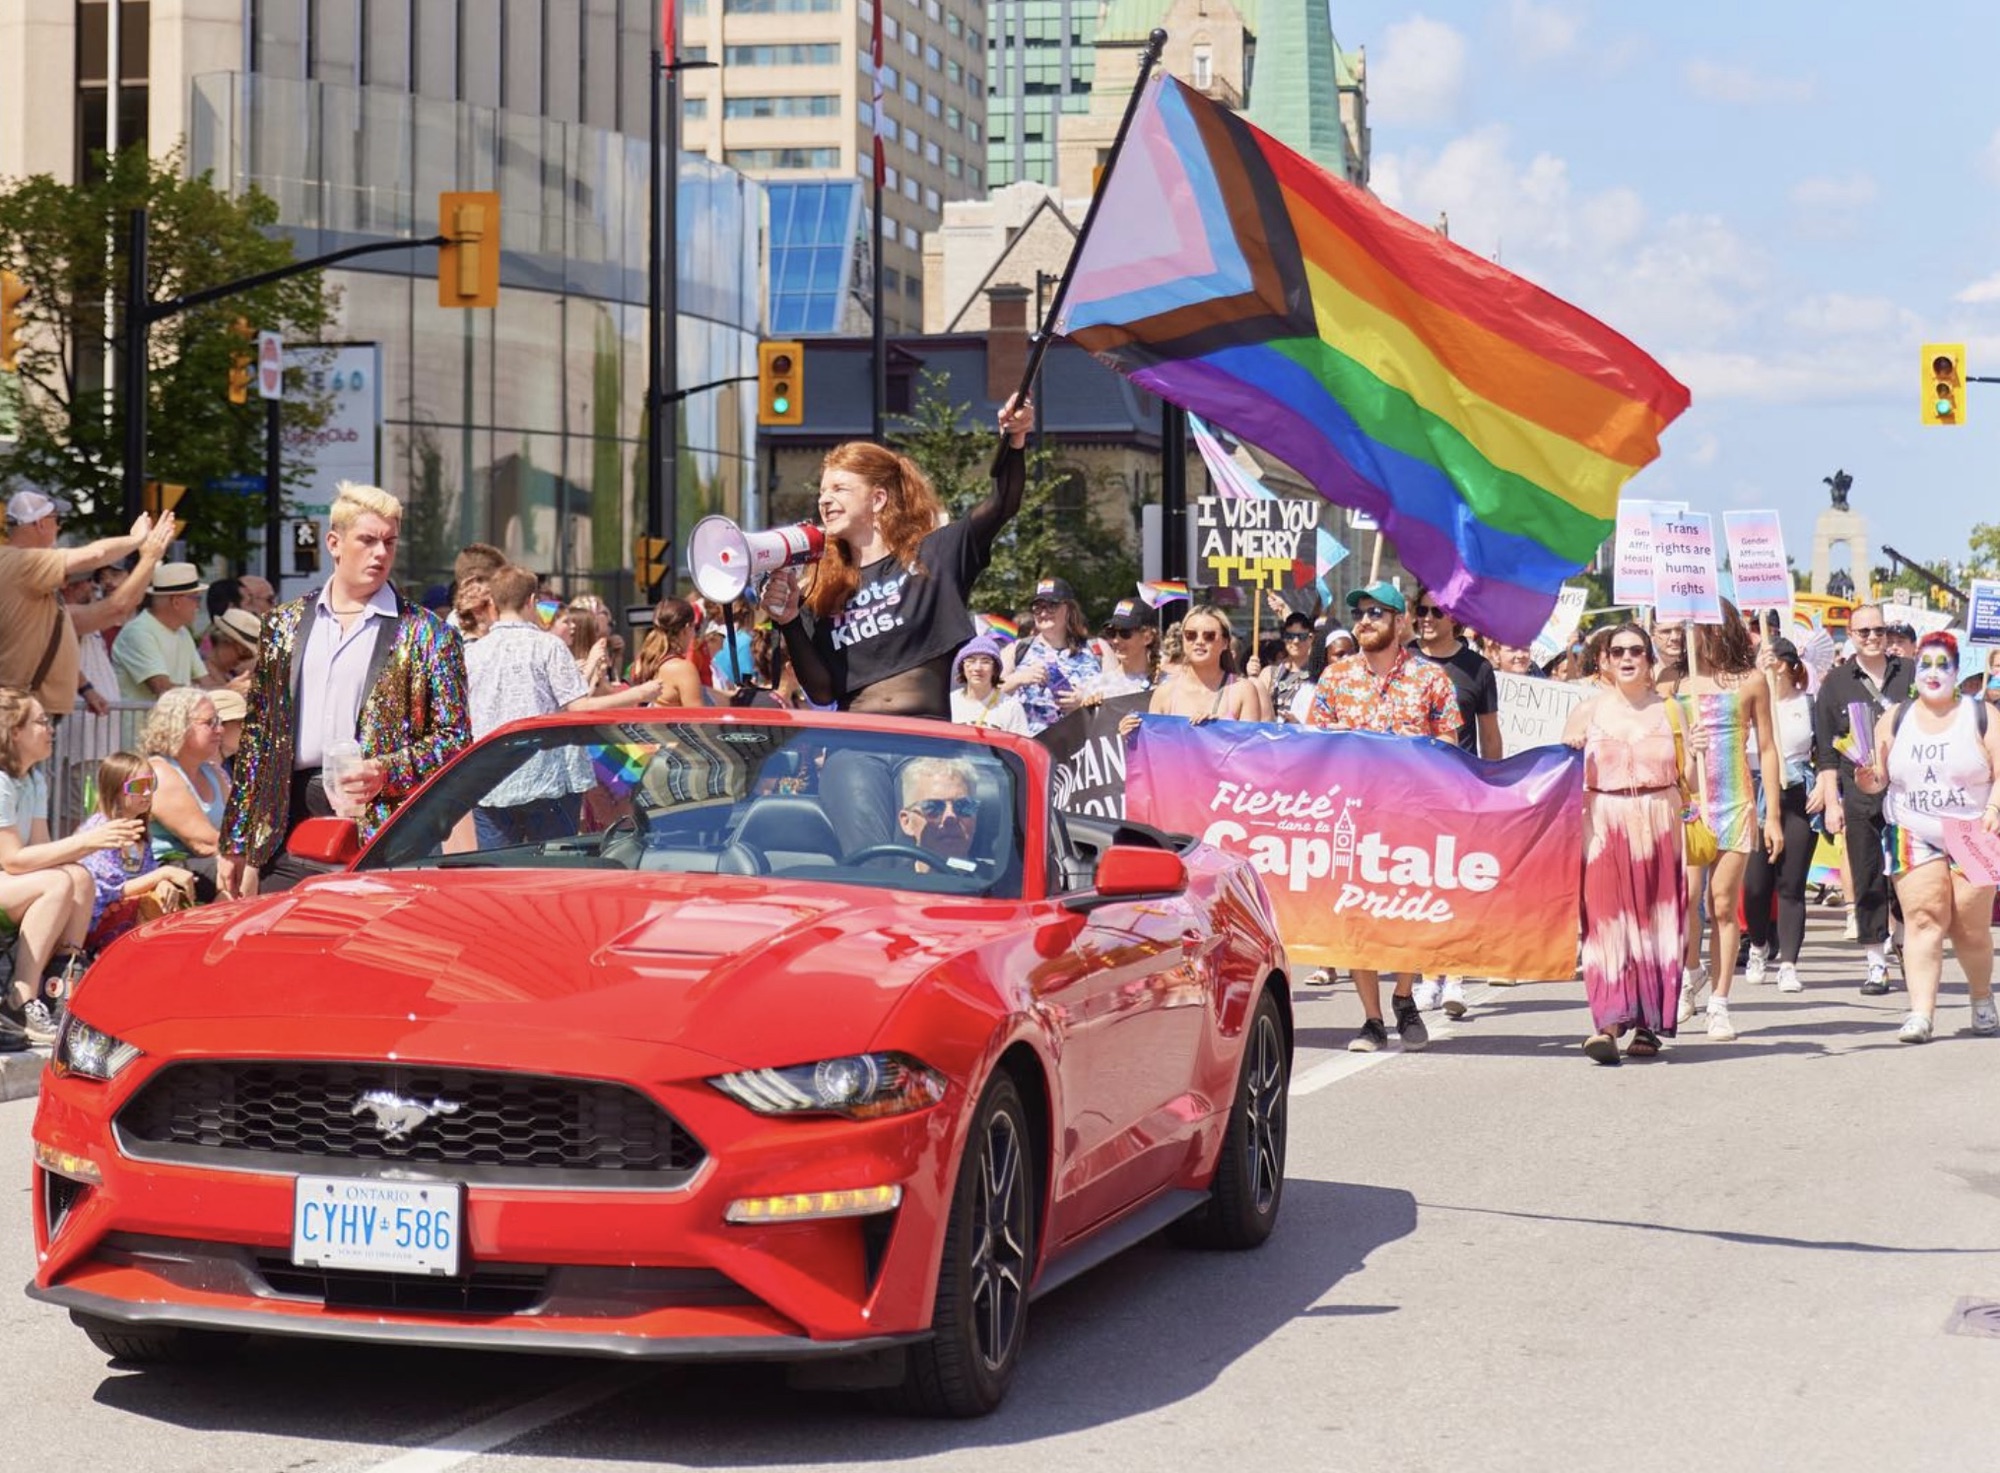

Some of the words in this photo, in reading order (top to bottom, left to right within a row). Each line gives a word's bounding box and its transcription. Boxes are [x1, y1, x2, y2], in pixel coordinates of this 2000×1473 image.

[1198, 496, 1217, 526] I
[1221, 497, 1271, 529] WISH
[1276, 499, 1321, 533] YOU
[1666, 522, 1699, 536] Trans
[1201, 528, 1225, 558] A
[1231, 528, 1303, 560] MERRY
[1655, 542, 1691, 557] rights
[1693, 545, 1711, 556] are
[1208, 555, 1292, 591] T4T
[1665, 562, 1706, 576] human
[1671, 581, 1705, 597] rights
[831, 613, 904, 651] Kids.
[1511, 713, 1546, 738] NOT
[1911, 743, 1950, 763] NOT
[1924, 765, 1937, 784] A
[1210, 780, 1342, 819] Fierté
[1276, 819, 1312, 832] dans
[1314, 820, 1331, 833] la
[1334, 883, 1454, 923] Pride
[346, 1185, 410, 1202] ONTARIO
[303, 1201, 377, 1246] CYHV
[395, 1207, 450, 1251] 586
